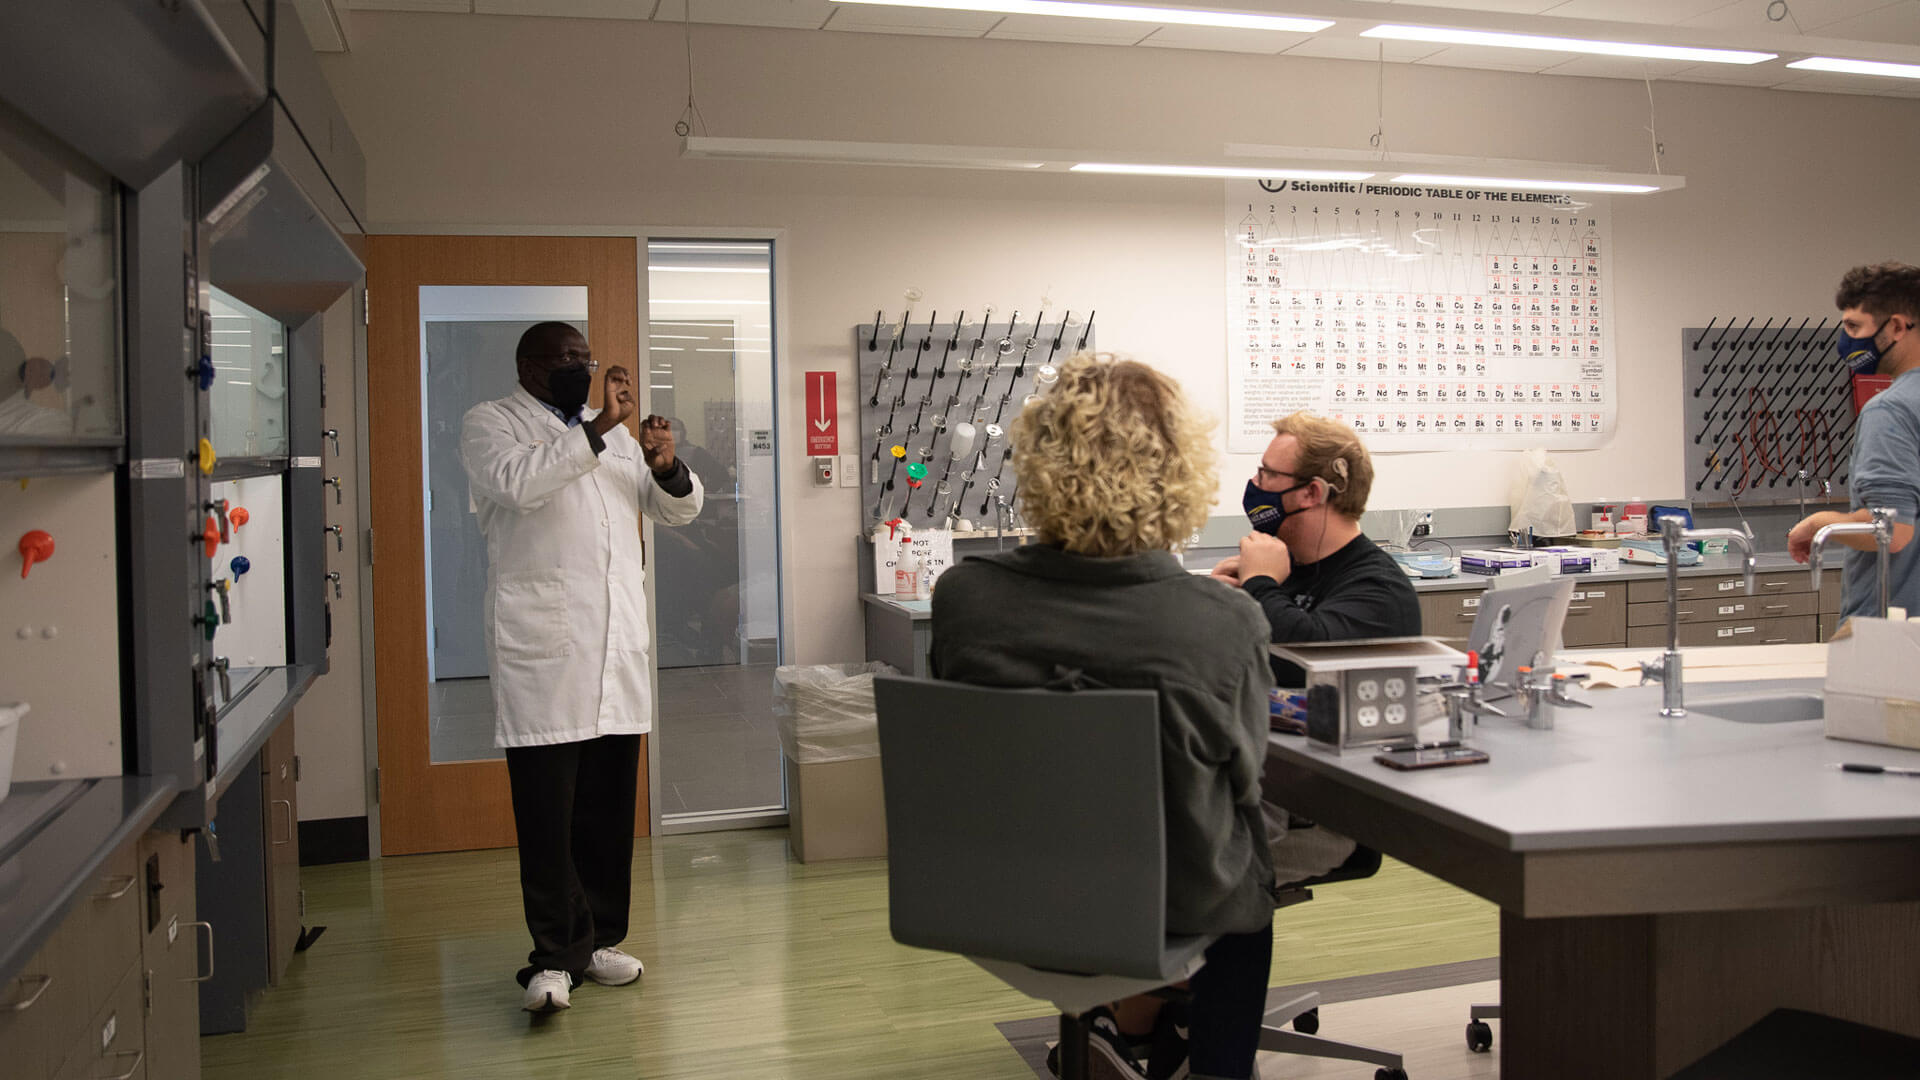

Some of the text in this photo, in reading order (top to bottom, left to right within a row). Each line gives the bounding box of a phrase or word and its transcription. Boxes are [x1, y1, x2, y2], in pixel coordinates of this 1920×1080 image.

[1291, 181, 1355, 193] Scientific
[1366, 185, 1422, 197] PERIODIC
[1426, 188, 1463, 199] TABLE
[1466, 190, 1480, 200] OF
[1484, 192, 1508, 201] THE
[1511, 193, 1571, 204] ELEMENTS
[1249, 204, 1252, 212] 1
[1270, 205, 1275, 213] 2
[1334, 207, 1339, 215] 5
[1414, 211, 1420, 219] 9
[1453, 213, 1461, 221] 11
[1473, 214, 1480, 222] 12
[1532, 216, 1540, 224] 15
[1588, 219, 1595, 227] 18
